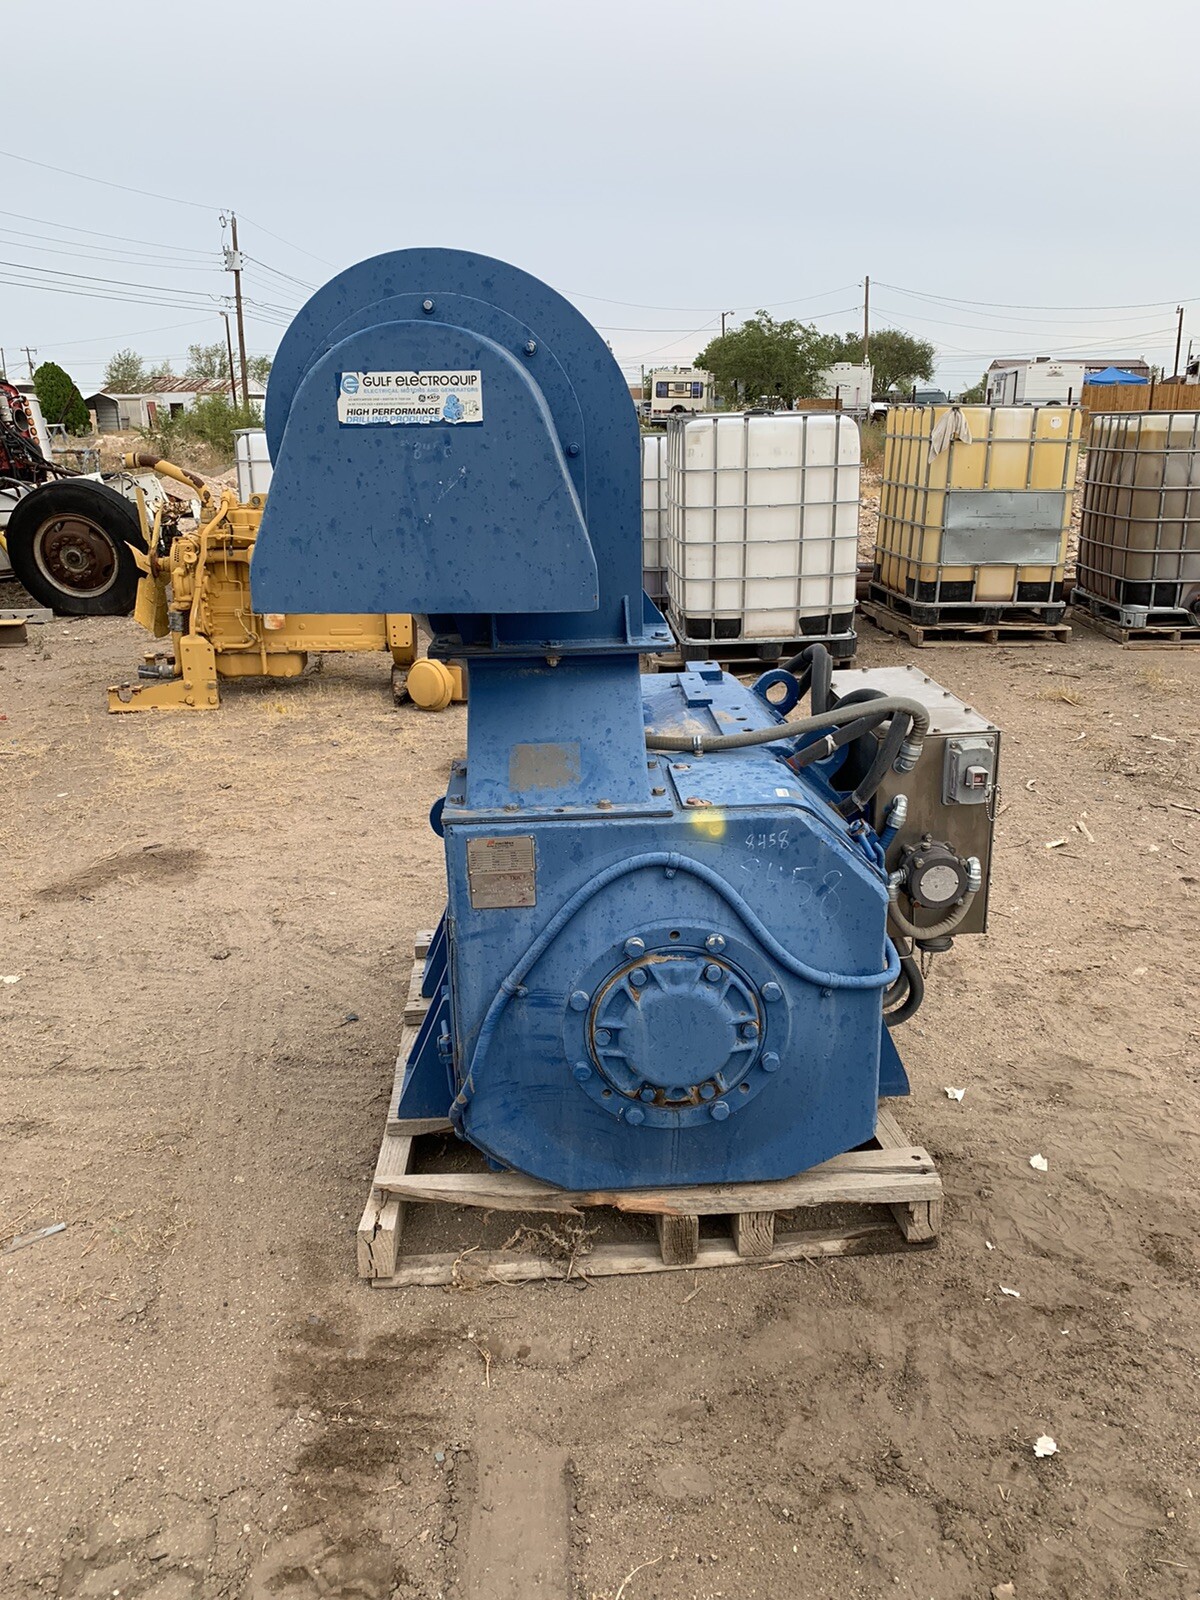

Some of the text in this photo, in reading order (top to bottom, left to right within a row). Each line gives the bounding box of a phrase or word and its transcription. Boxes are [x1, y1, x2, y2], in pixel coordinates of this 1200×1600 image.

[363, 375, 392, 387] GULF
[346, 407, 441, 416] HIGH PERFORMANCE
[346, 415, 440, 423] DRILLING PRODUCTS
[745, 829, 789, 850] 8458
